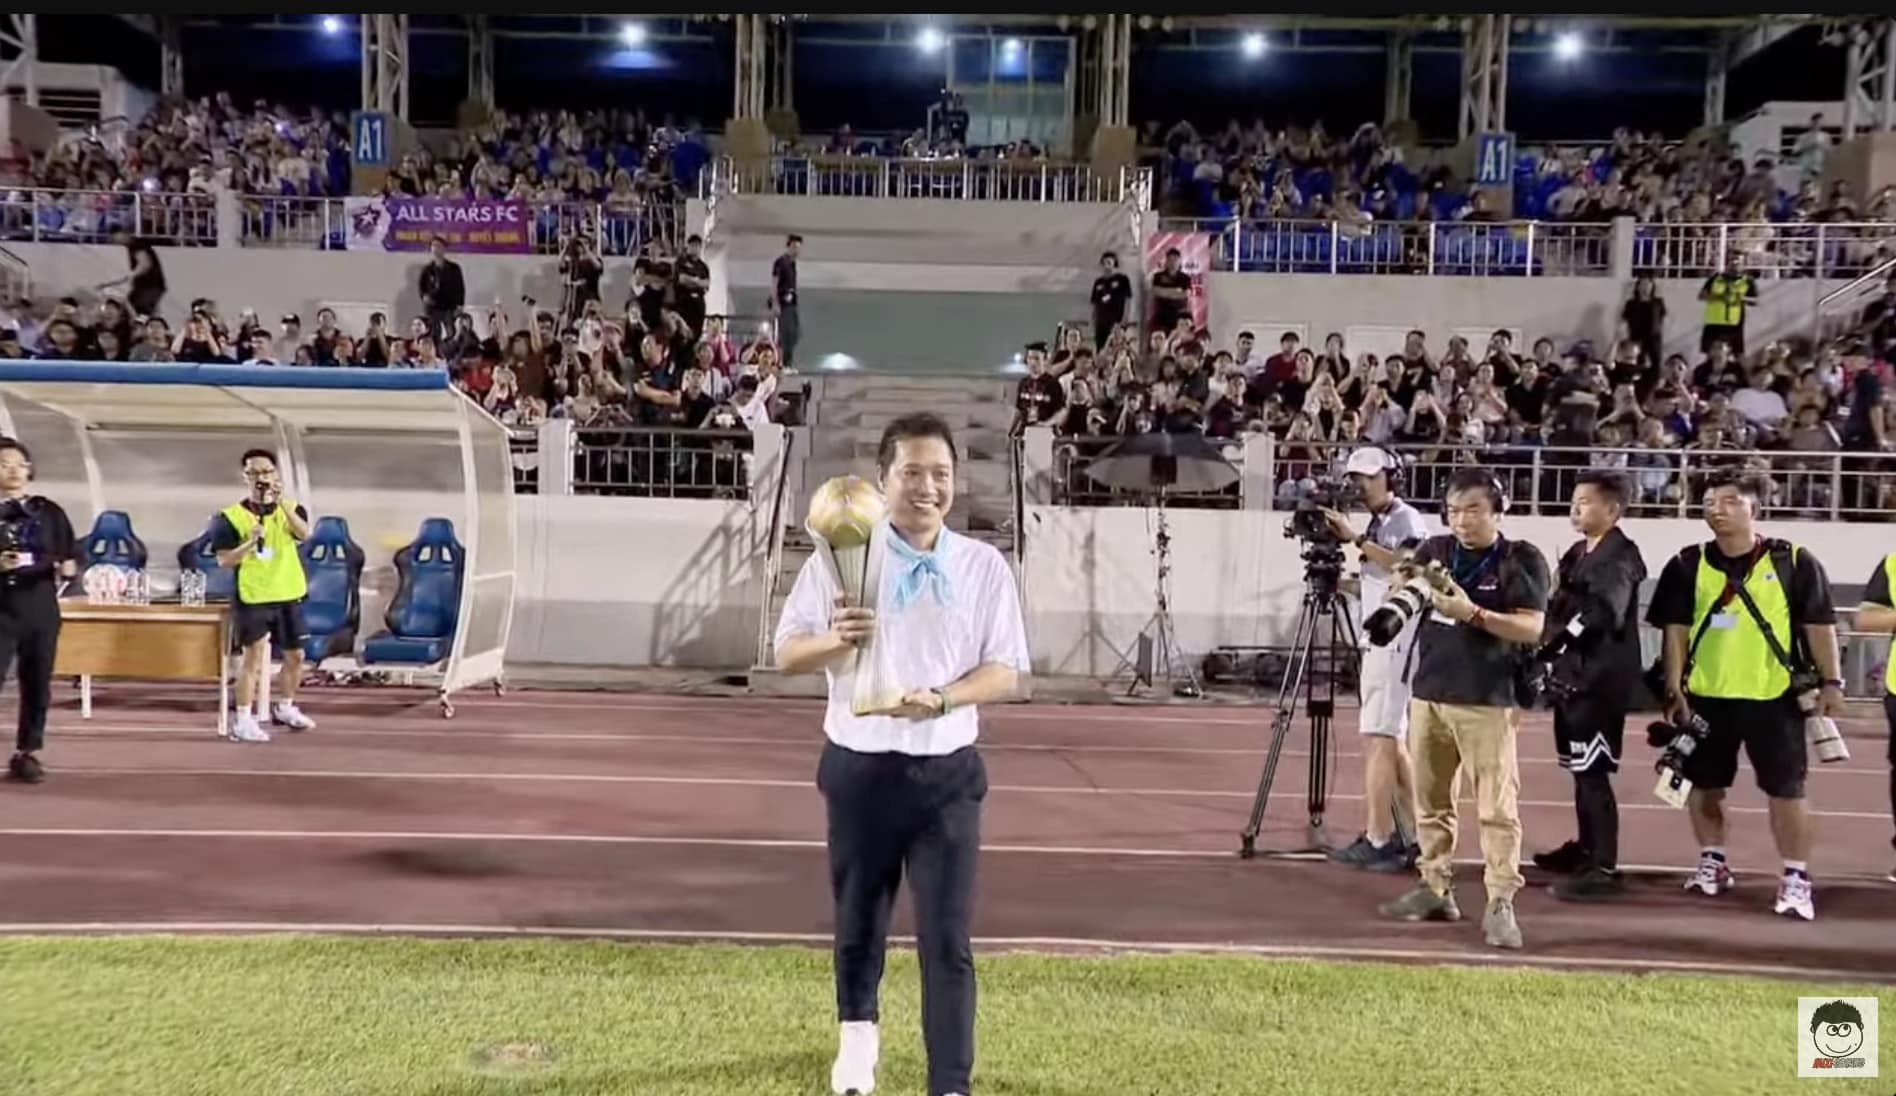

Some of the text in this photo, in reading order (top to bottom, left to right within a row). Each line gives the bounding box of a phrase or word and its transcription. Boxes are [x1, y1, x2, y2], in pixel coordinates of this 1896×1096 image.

[358, 118, 382, 160] A1
[1480, 140, 1507, 181] A1
[396, 205, 519, 222] ALL STARS FC
[1407, 367, 1423, 385] 7
